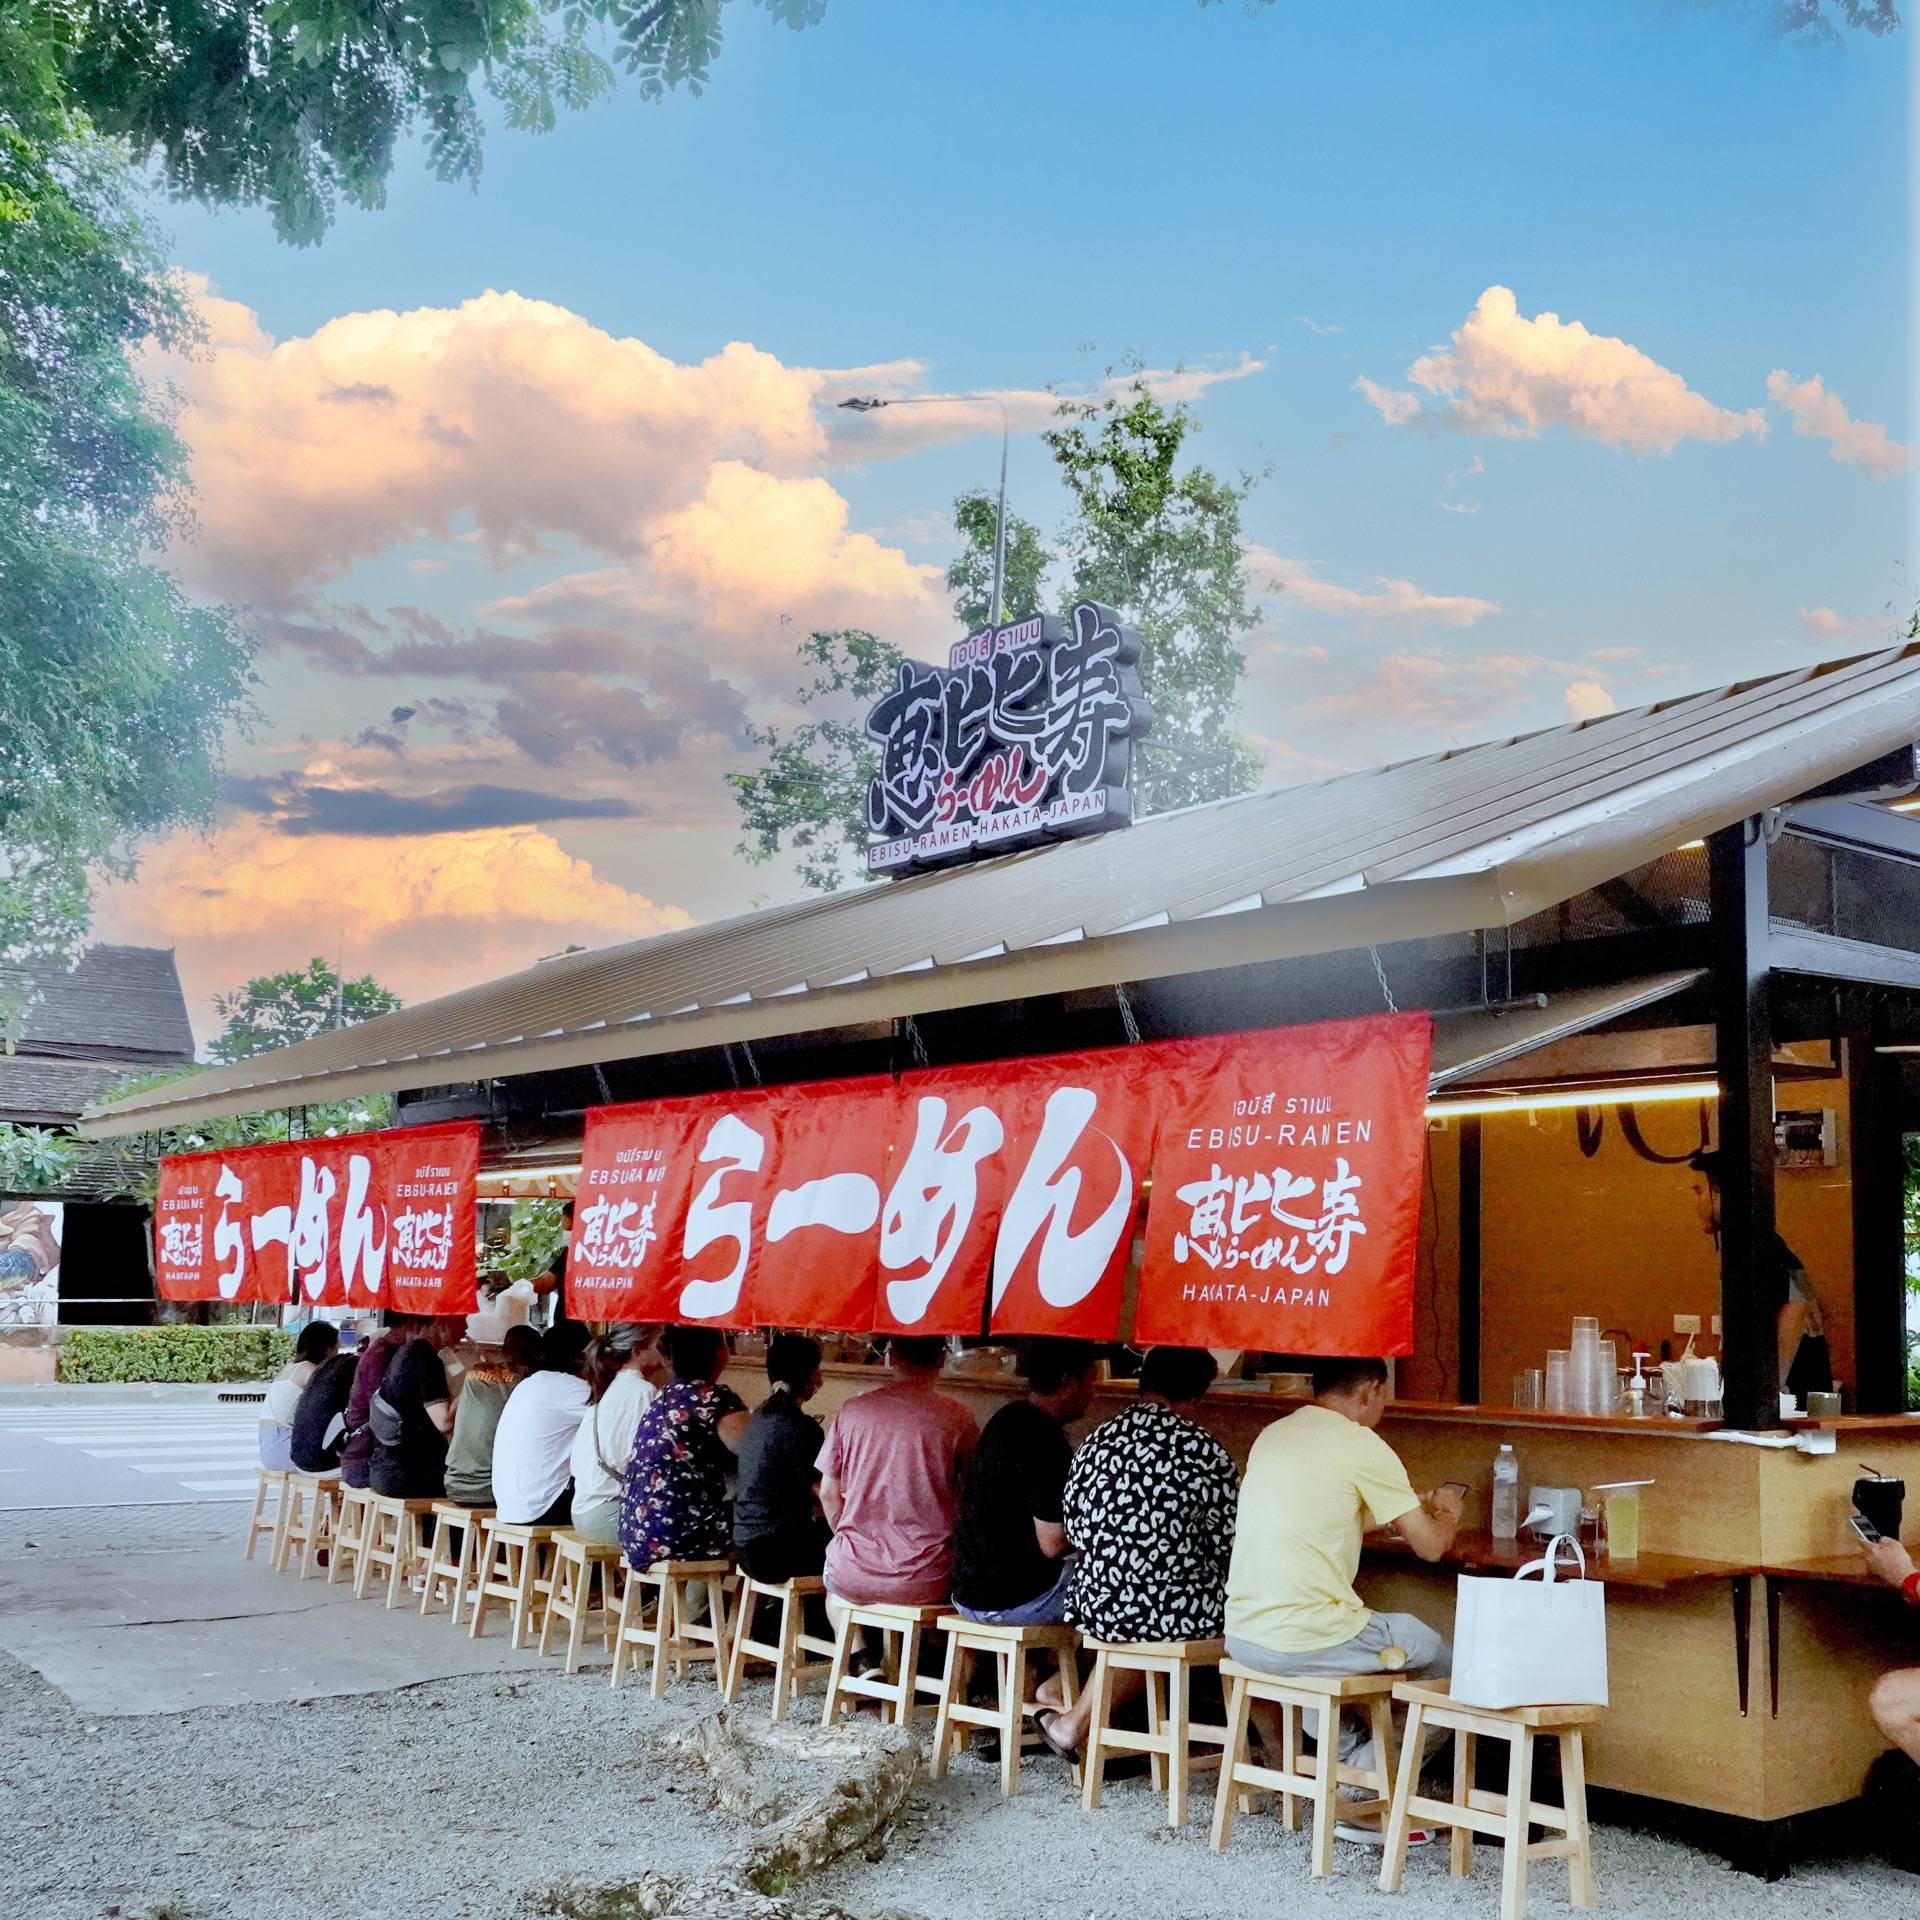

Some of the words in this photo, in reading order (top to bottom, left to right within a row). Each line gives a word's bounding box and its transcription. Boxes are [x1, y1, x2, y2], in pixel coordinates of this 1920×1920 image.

[998, 620, 1040, 650] ราเมน
[213, 1154, 388, 1300] らーめん
[679, 1086, 1133, 1326] らーめん
